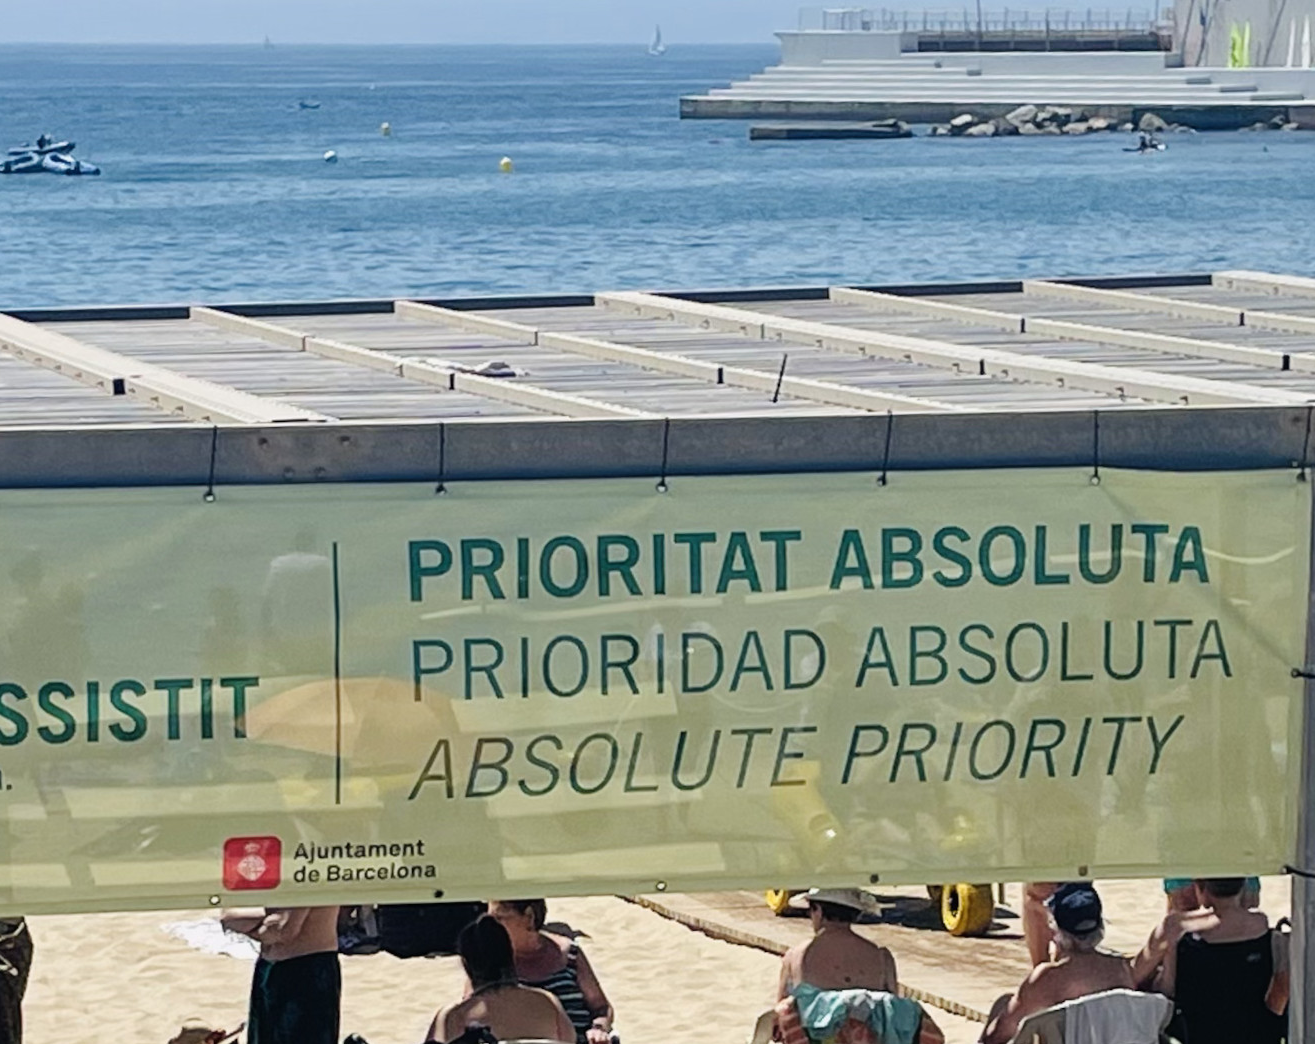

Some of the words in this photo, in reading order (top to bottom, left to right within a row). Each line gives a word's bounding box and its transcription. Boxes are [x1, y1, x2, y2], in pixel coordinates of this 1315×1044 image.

[407, 530, 803, 602] PRIORITAT
[829, 523, 1211, 591] ABSOLUTA
[412, 629, 827, 702] PRIORIDAD
[855, 619, 1233, 688] ABSOLUTA
[407, 726, 819, 801] ABSOLUTE
[840, 714, 1186, 785] PRIORITY
[292, 838, 426, 864] Ajuntament
[292, 865, 321, 883] de
[326, 862, 437, 883] Barcelona
